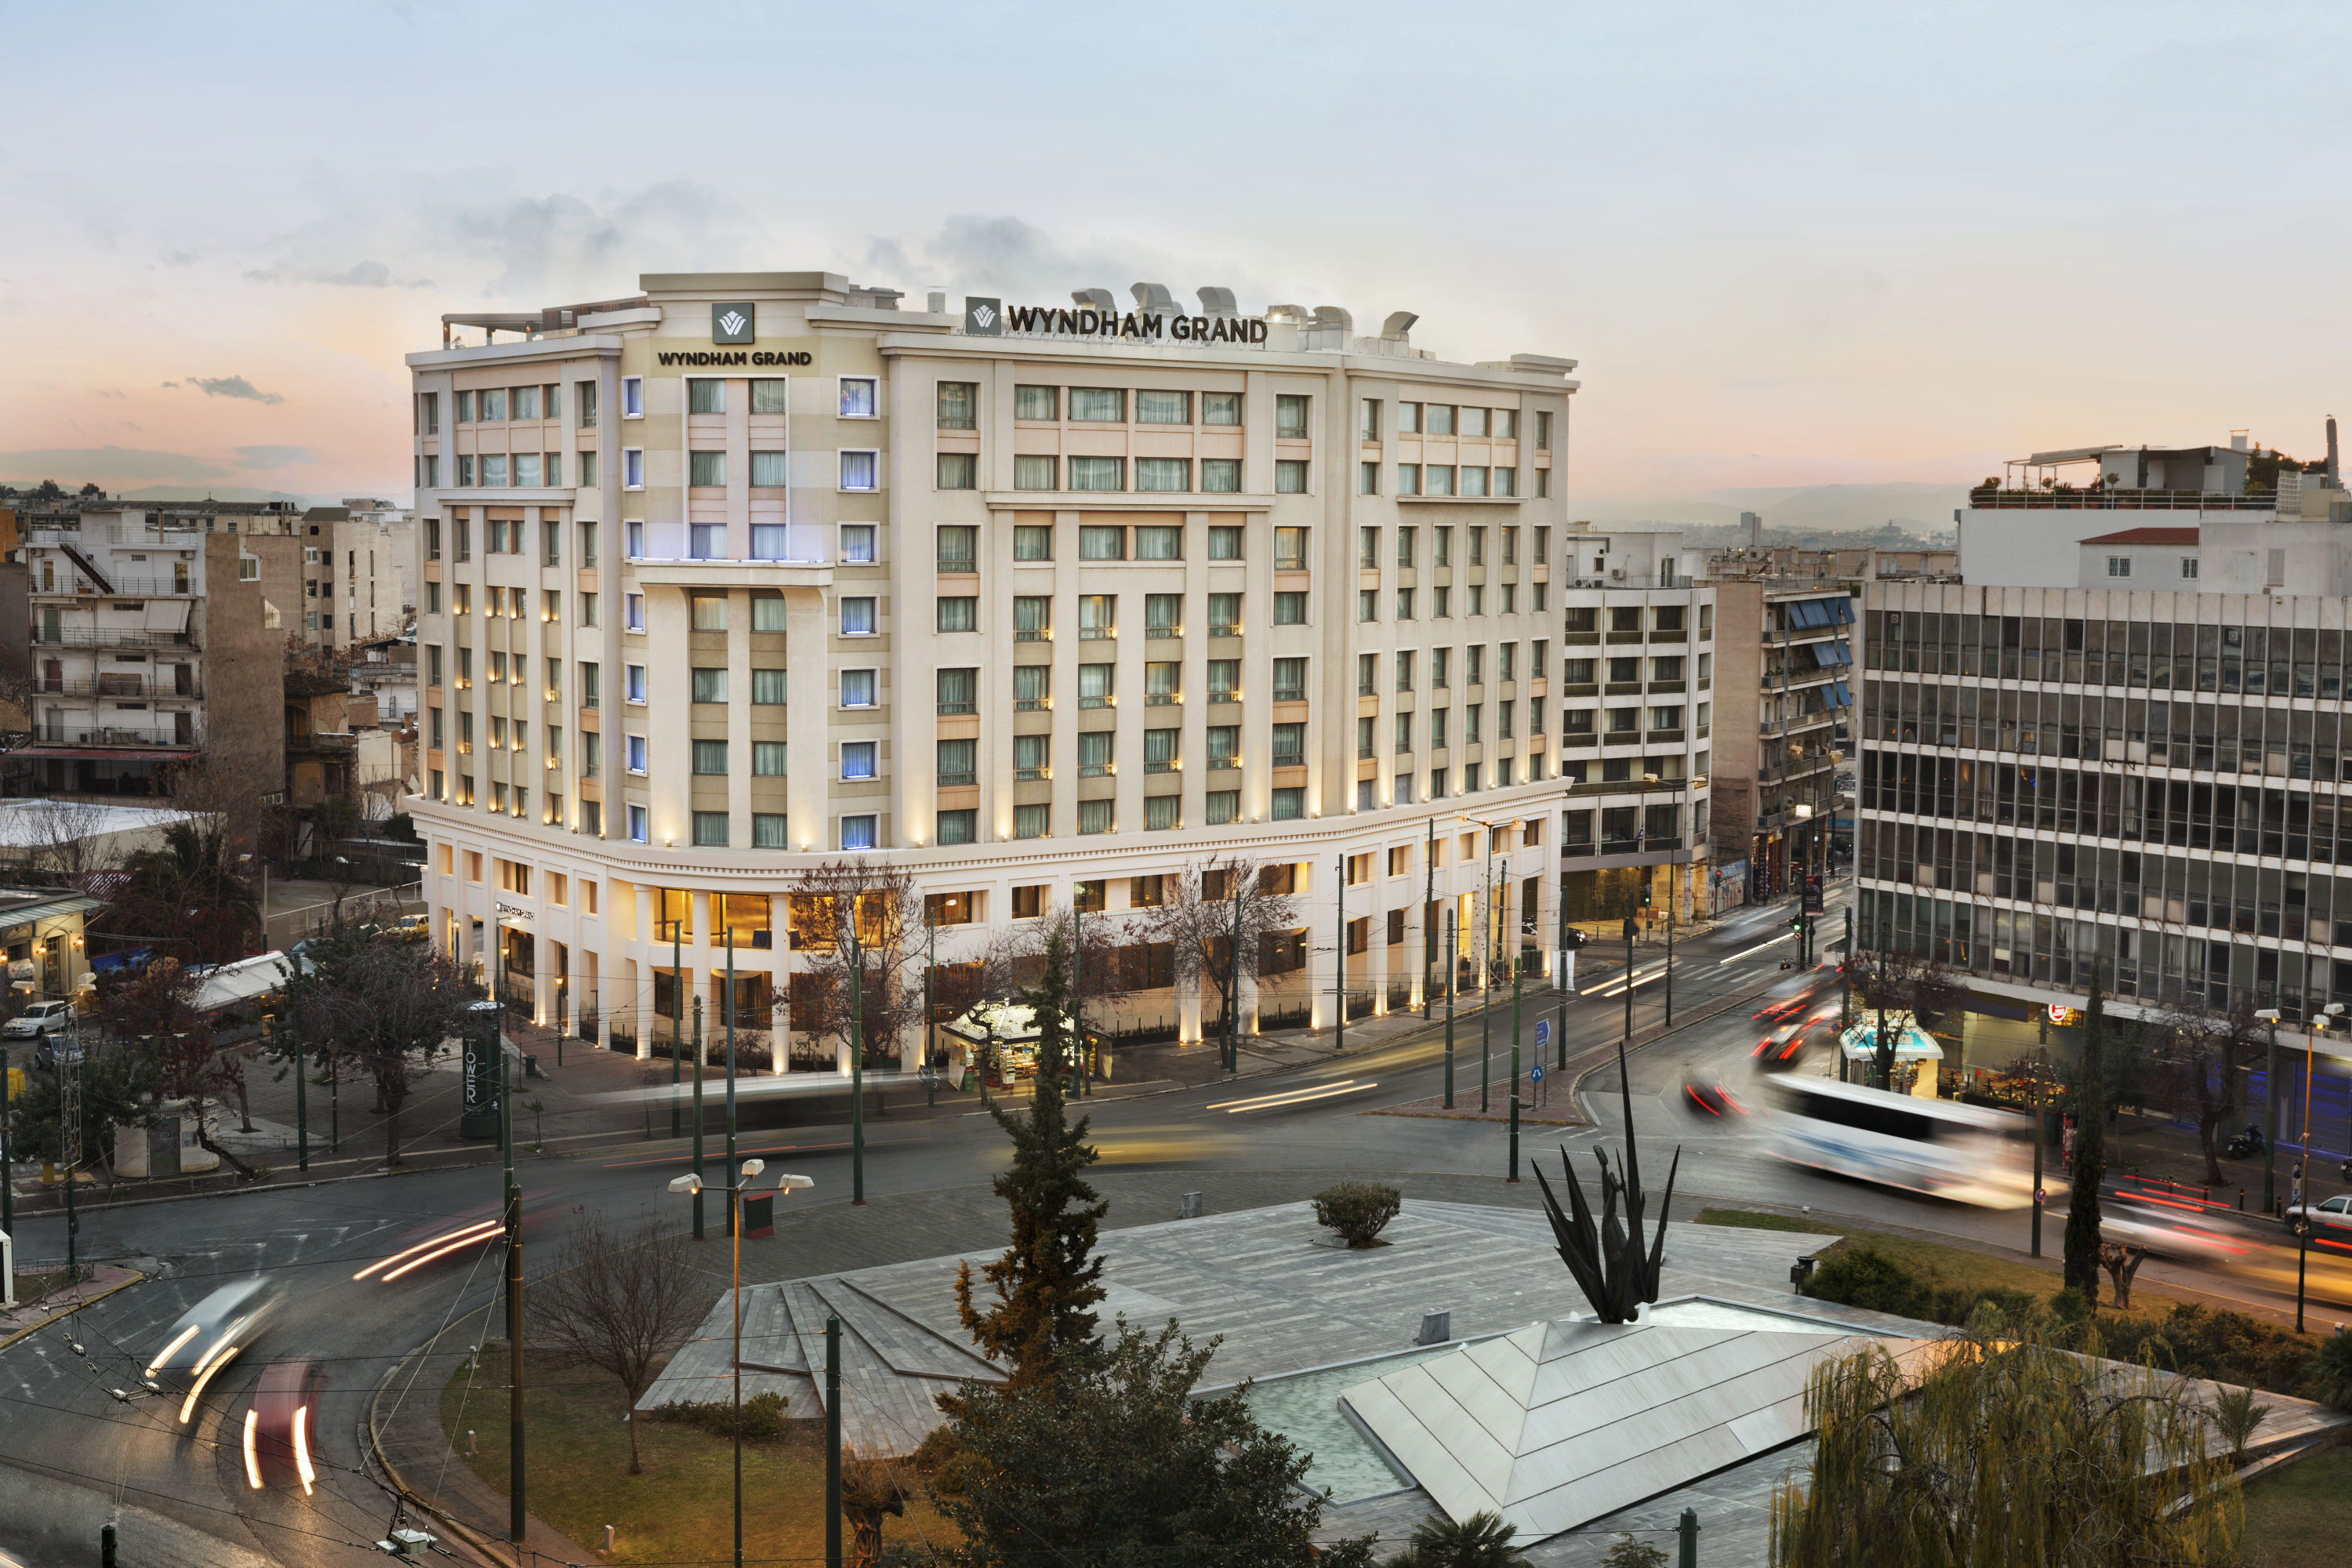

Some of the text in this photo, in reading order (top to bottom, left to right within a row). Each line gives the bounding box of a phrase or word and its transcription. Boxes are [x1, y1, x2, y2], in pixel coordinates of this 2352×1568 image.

[1007, 305, 1269, 343] WYNDHAM GRAND
[658, 352, 812, 366] WYNDHAM GRAND
[502, 905, 535, 920] WYNDHAM GRAND
[465, 1038, 477, 1104] TOWER
